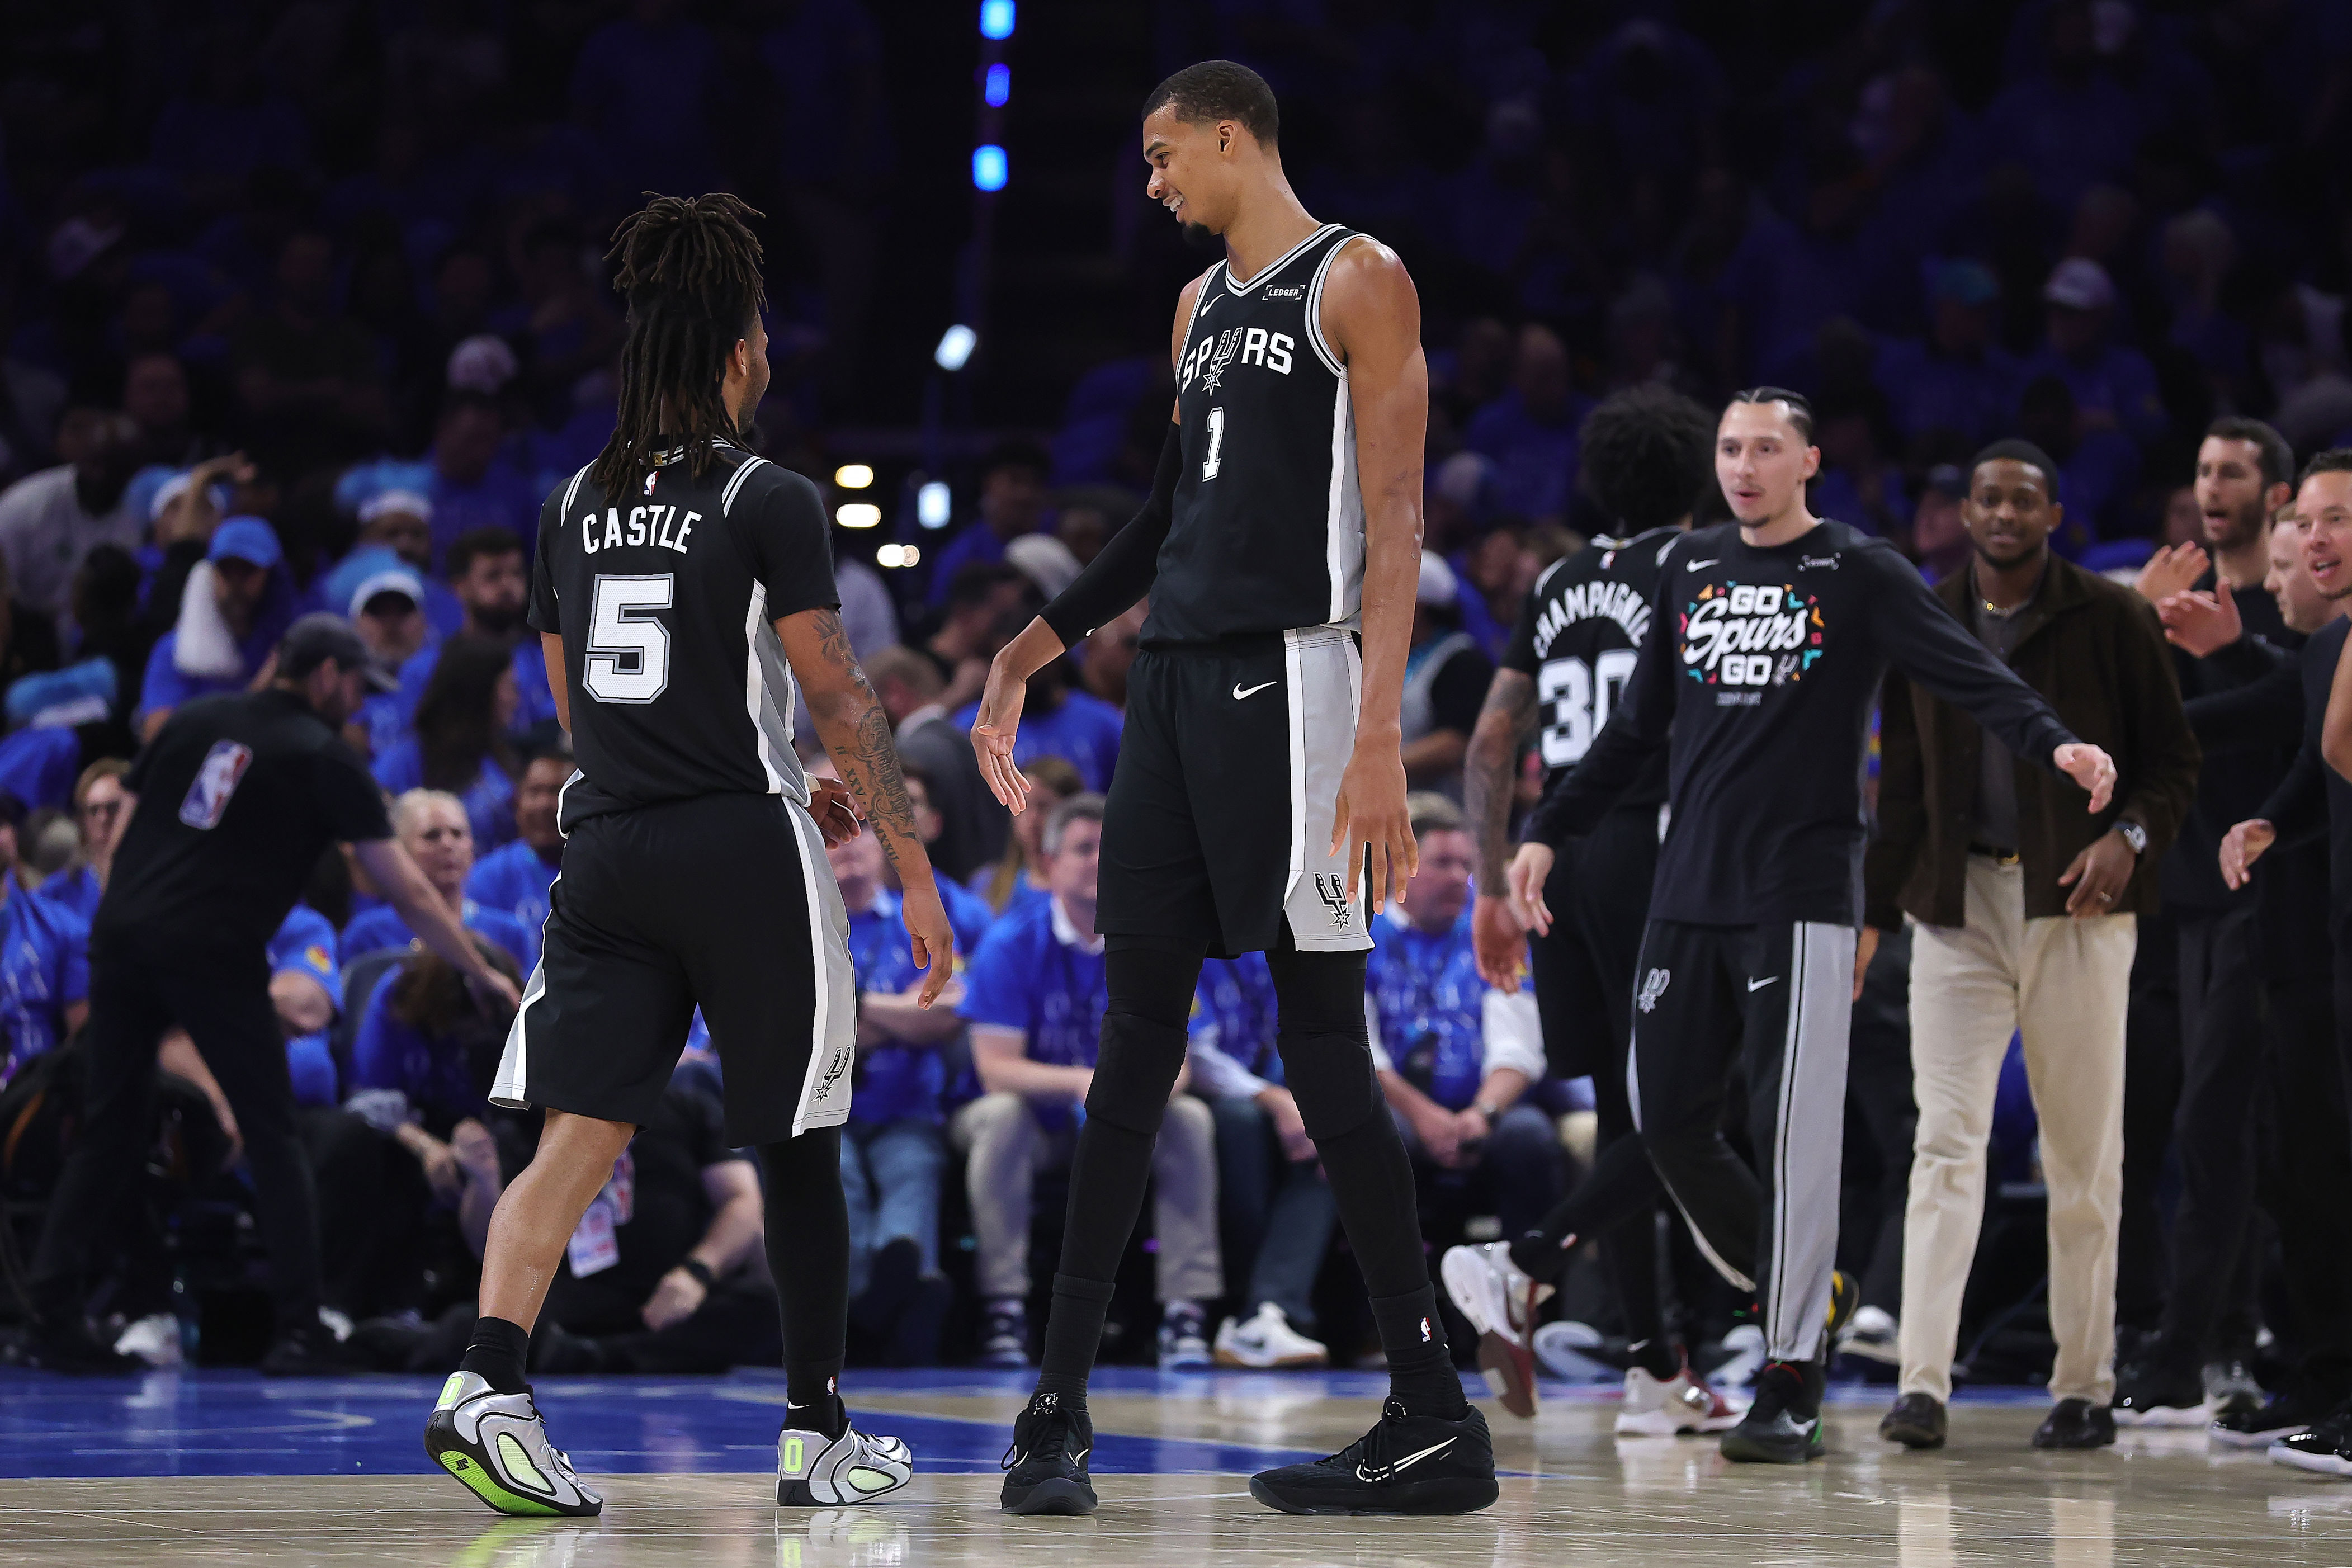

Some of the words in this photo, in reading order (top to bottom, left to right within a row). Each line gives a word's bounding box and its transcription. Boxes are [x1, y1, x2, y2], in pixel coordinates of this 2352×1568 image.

[1268, 288, 1299, 297] LEDGER
[1182, 327, 1295, 396] SPURS
[1202, 406, 1225, 483] 1
[582, 504, 702, 554] CASTLE
[1683, 597, 1809, 671] Spurs
[1728, 585, 1784, 615] GO
[582, 572, 674, 705] 5
[1721, 654, 1773, 686] GO
[1537, 649, 1640, 768] 30
